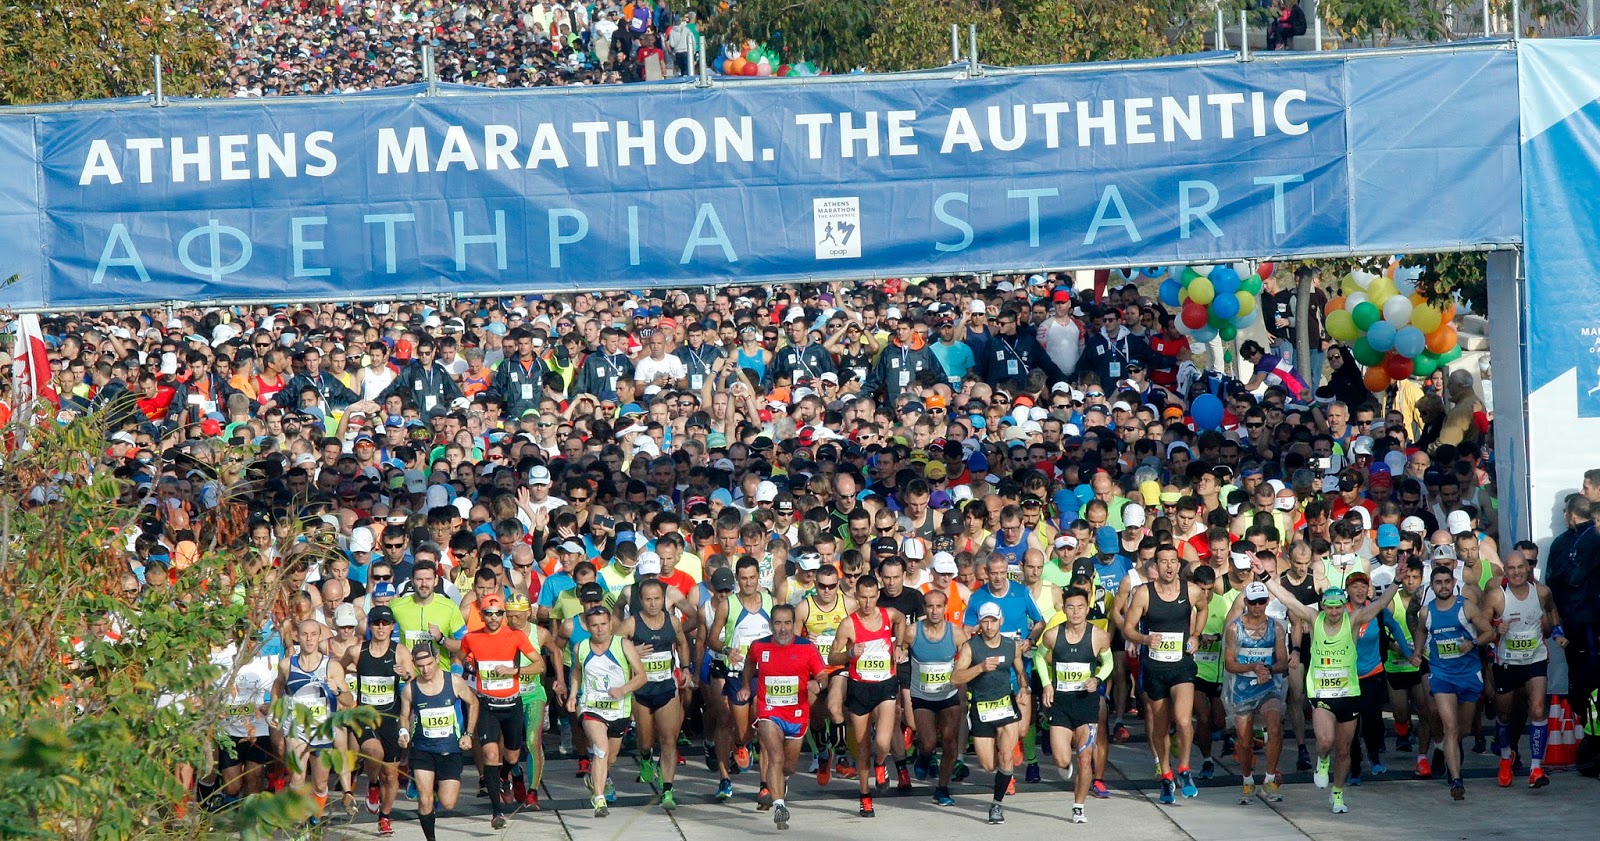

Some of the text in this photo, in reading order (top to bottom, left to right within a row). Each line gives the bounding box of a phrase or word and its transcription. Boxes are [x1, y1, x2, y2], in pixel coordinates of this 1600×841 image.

[79, 88, 1309, 185] ATHENS MARATHON. THE AUTHENTIC
[934, 174, 1306, 253] START
[92, 203, 739, 285] ΑΦΕΤΗΡΙΑ
[1511, 640, 1532, 648] 1303
[648, 661, 666, 670] 1351
[864, 660, 885, 668] 1350
[926, 673, 946, 682] 1356
[1064, 671, 1083, 680] 1199
[1321, 678, 1341, 687] 1856
[368, 684, 387, 693] 1210
[770, 685, 792, 694] 1988
[428, 716, 449, 726] 1362
